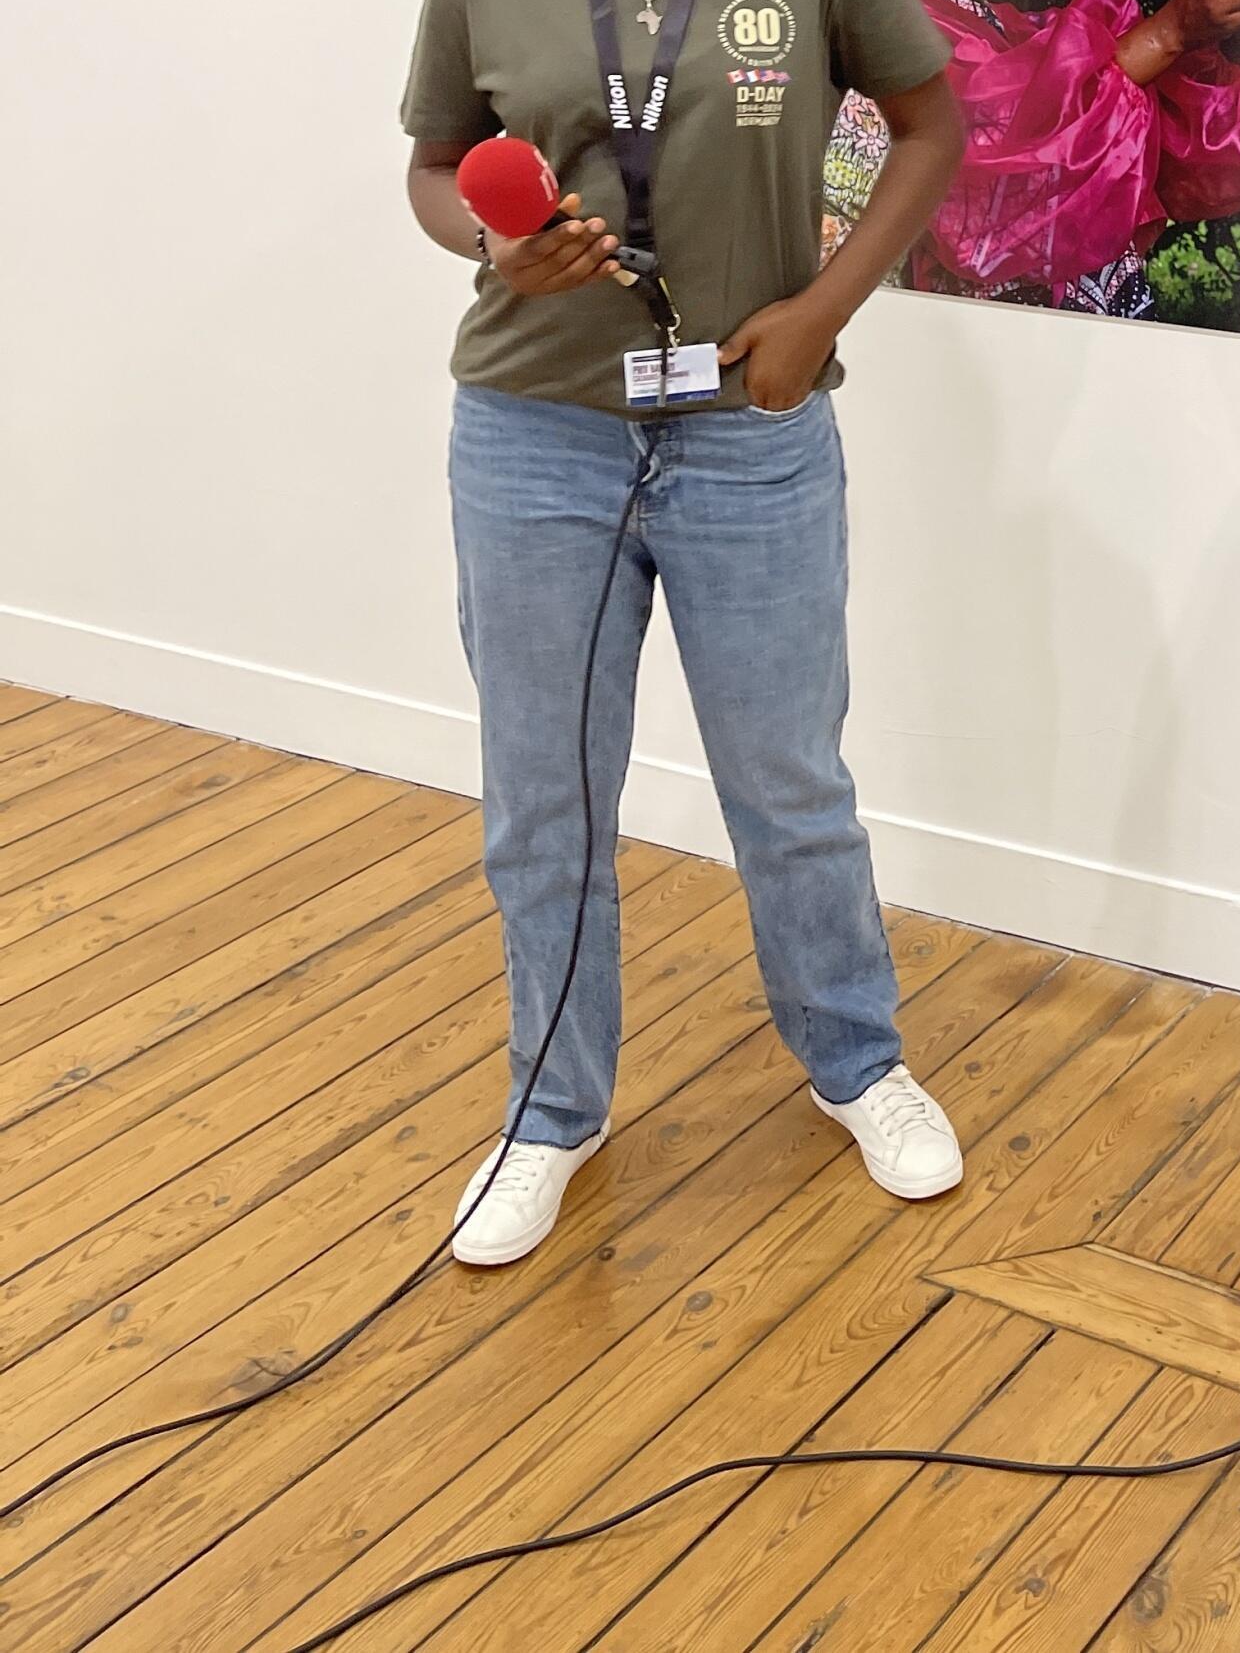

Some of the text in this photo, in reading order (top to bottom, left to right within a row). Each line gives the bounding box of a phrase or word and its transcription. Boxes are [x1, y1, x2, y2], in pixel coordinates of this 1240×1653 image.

[733, 7, 781, 46] 80
[607, 74, 633, 129] Nikon
[640, 75, 669, 132] Nikon
[736, 86, 786, 103] D-DAY
